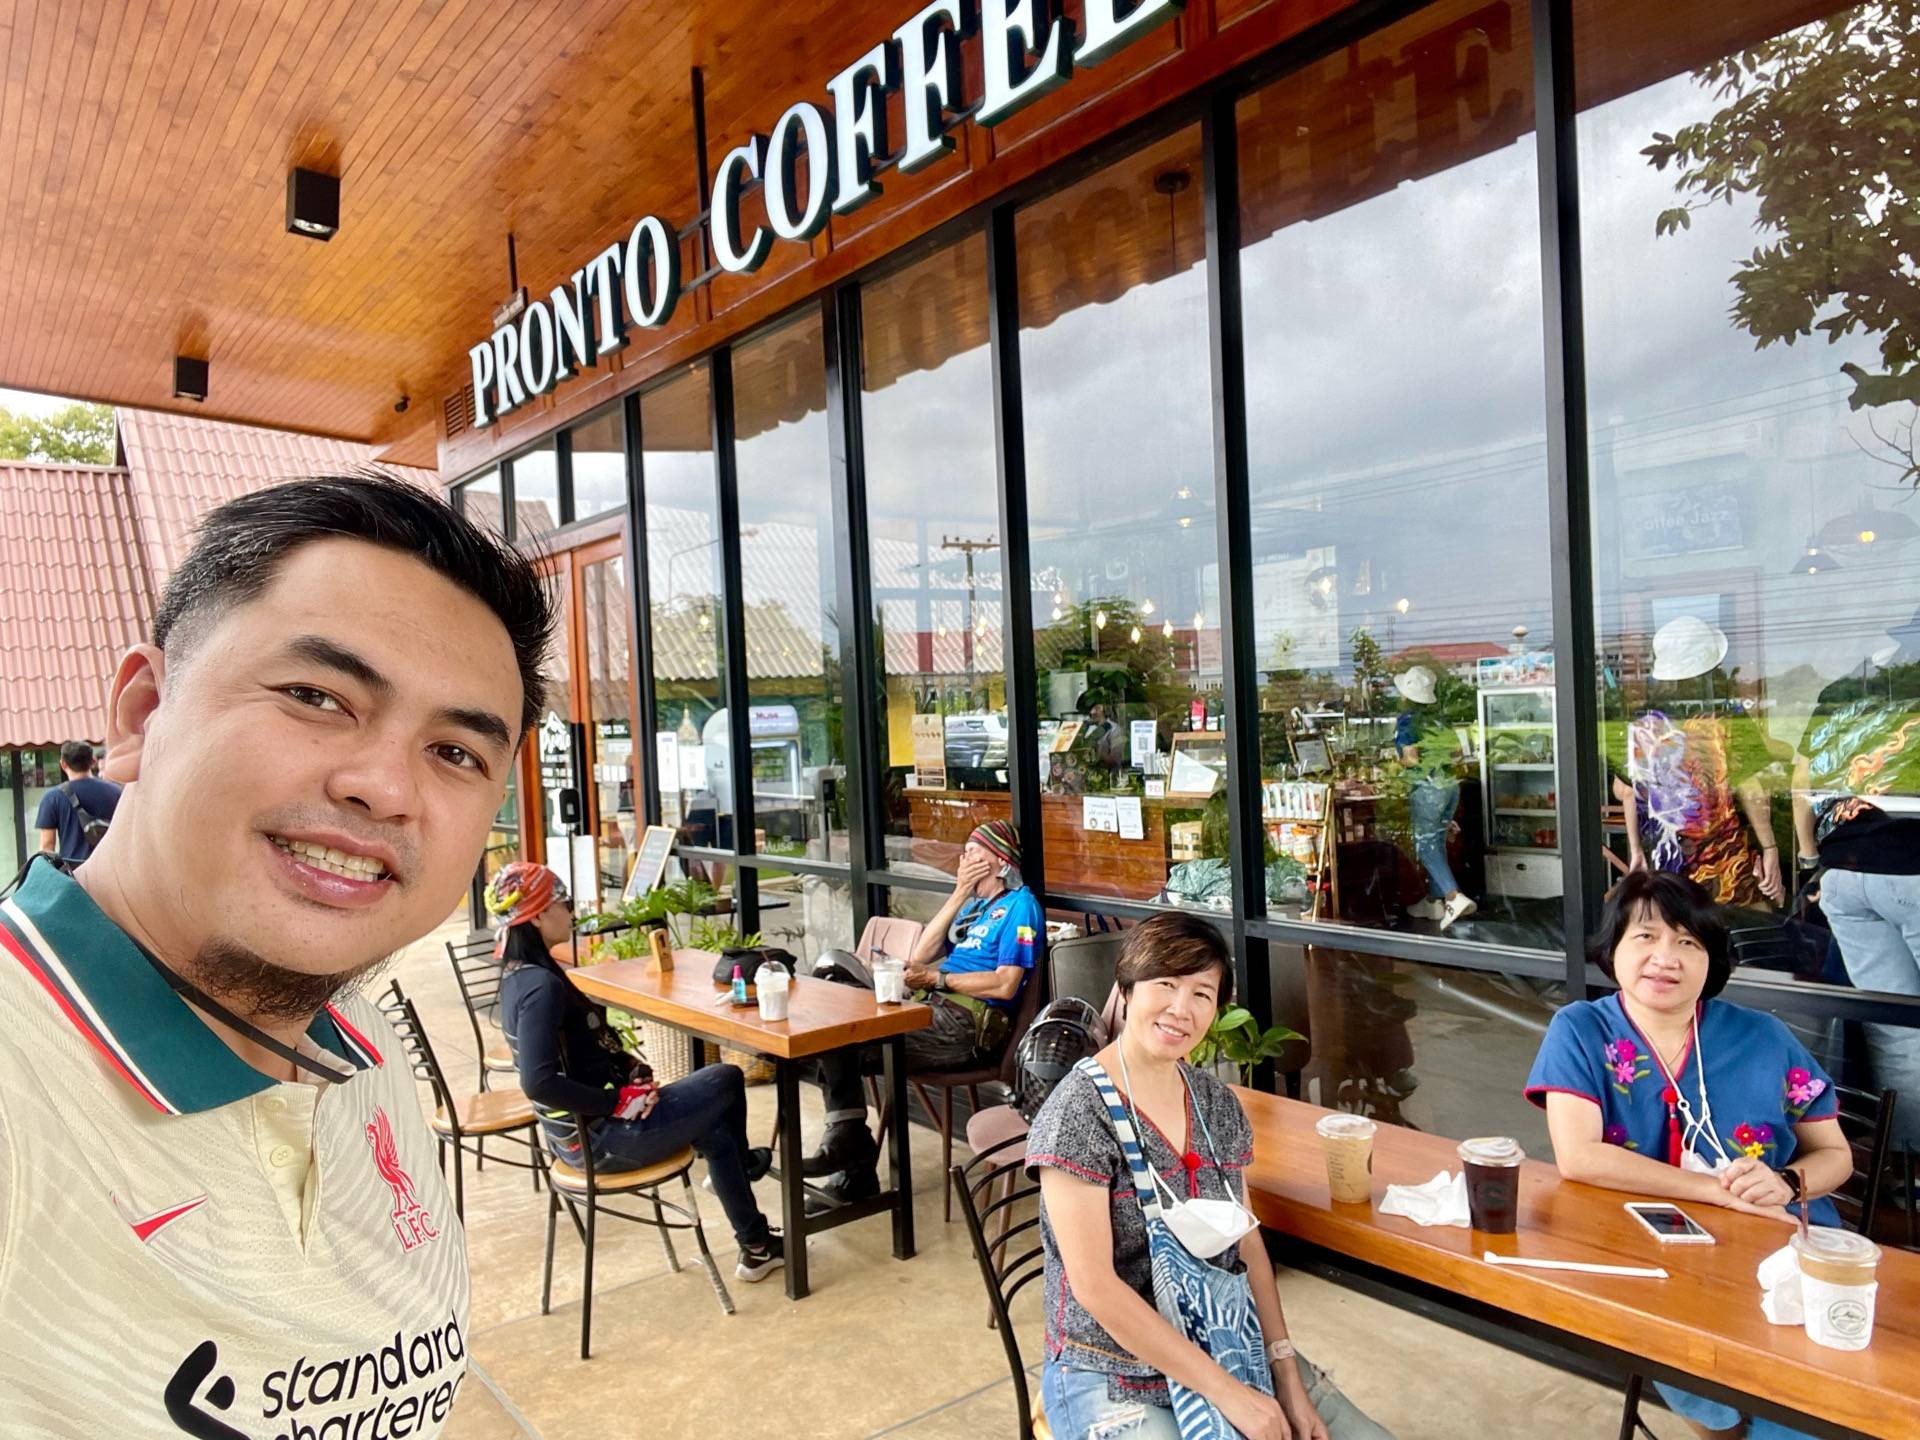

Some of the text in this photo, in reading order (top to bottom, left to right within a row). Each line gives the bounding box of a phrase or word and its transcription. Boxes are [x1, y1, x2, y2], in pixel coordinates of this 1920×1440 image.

[469, 215, 674, 429] PRONTO
[262, 1308, 465, 1418] standard
[273, 1371, 466, 1440] hartere
